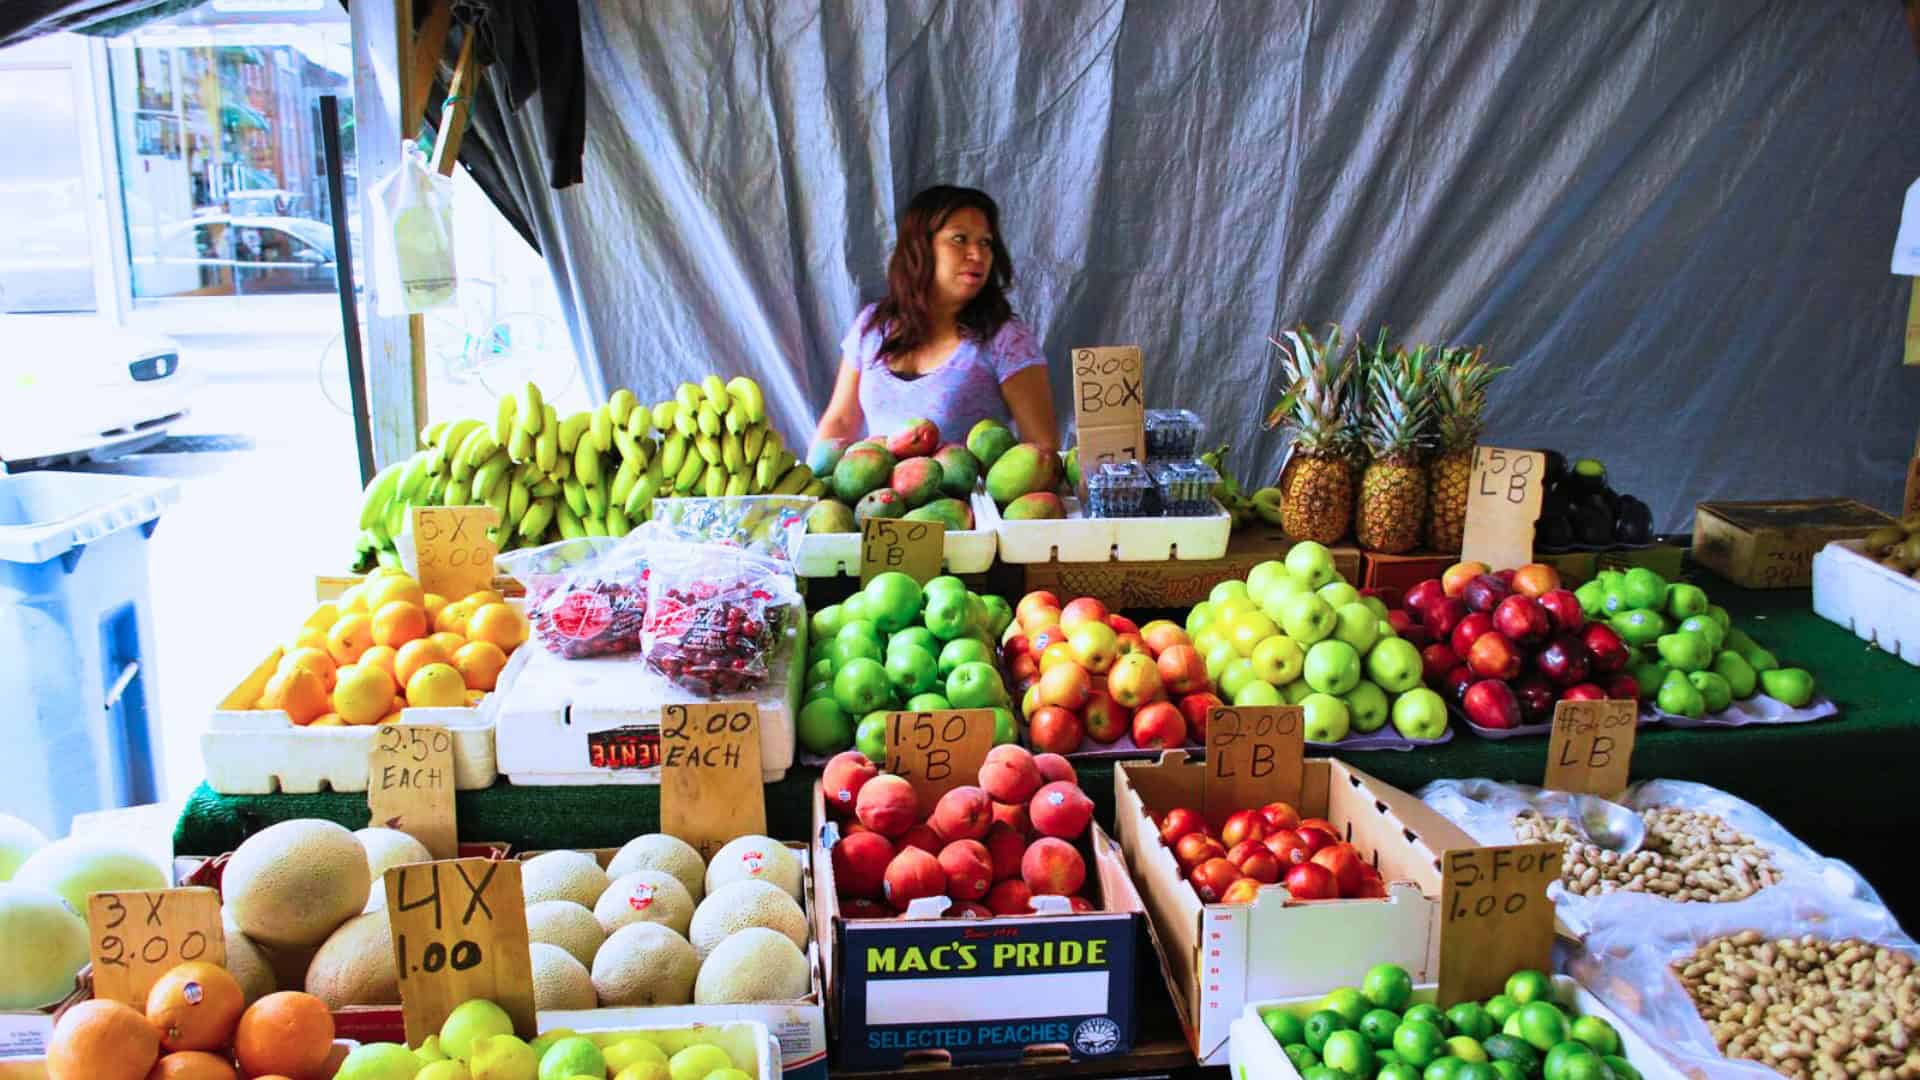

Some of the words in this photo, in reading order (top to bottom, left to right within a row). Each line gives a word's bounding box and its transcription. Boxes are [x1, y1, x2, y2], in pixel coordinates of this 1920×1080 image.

[1076, 350, 1138, 376] 2.00
[1082, 378, 1142, 413] BOX
[1473, 447, 1533, 474] 1.50
[863, 520, 927, 546] 1.50
[663, 704, 751, 741] 2.00
[894, 713, 966, 750] 1.50
[1213, 708, 1297, 746] 2.00
[381, 726, 449, 762] 2.50
[665, 743, 741, 769] EACH
[382, 765, 442, 790] EACH
[1449, 892, 1527, 922] 1.00
[99, 930, 207, 968] 2.00
[399, 934, 483, 981] 1.00
[866, 941, 978, 974] MAC'S
[992, 939, 1108, 969] PRIDE
[867, 1028, 973, 1050] SELECTED
[977, 1023, 1071, 1046] PEACHES
